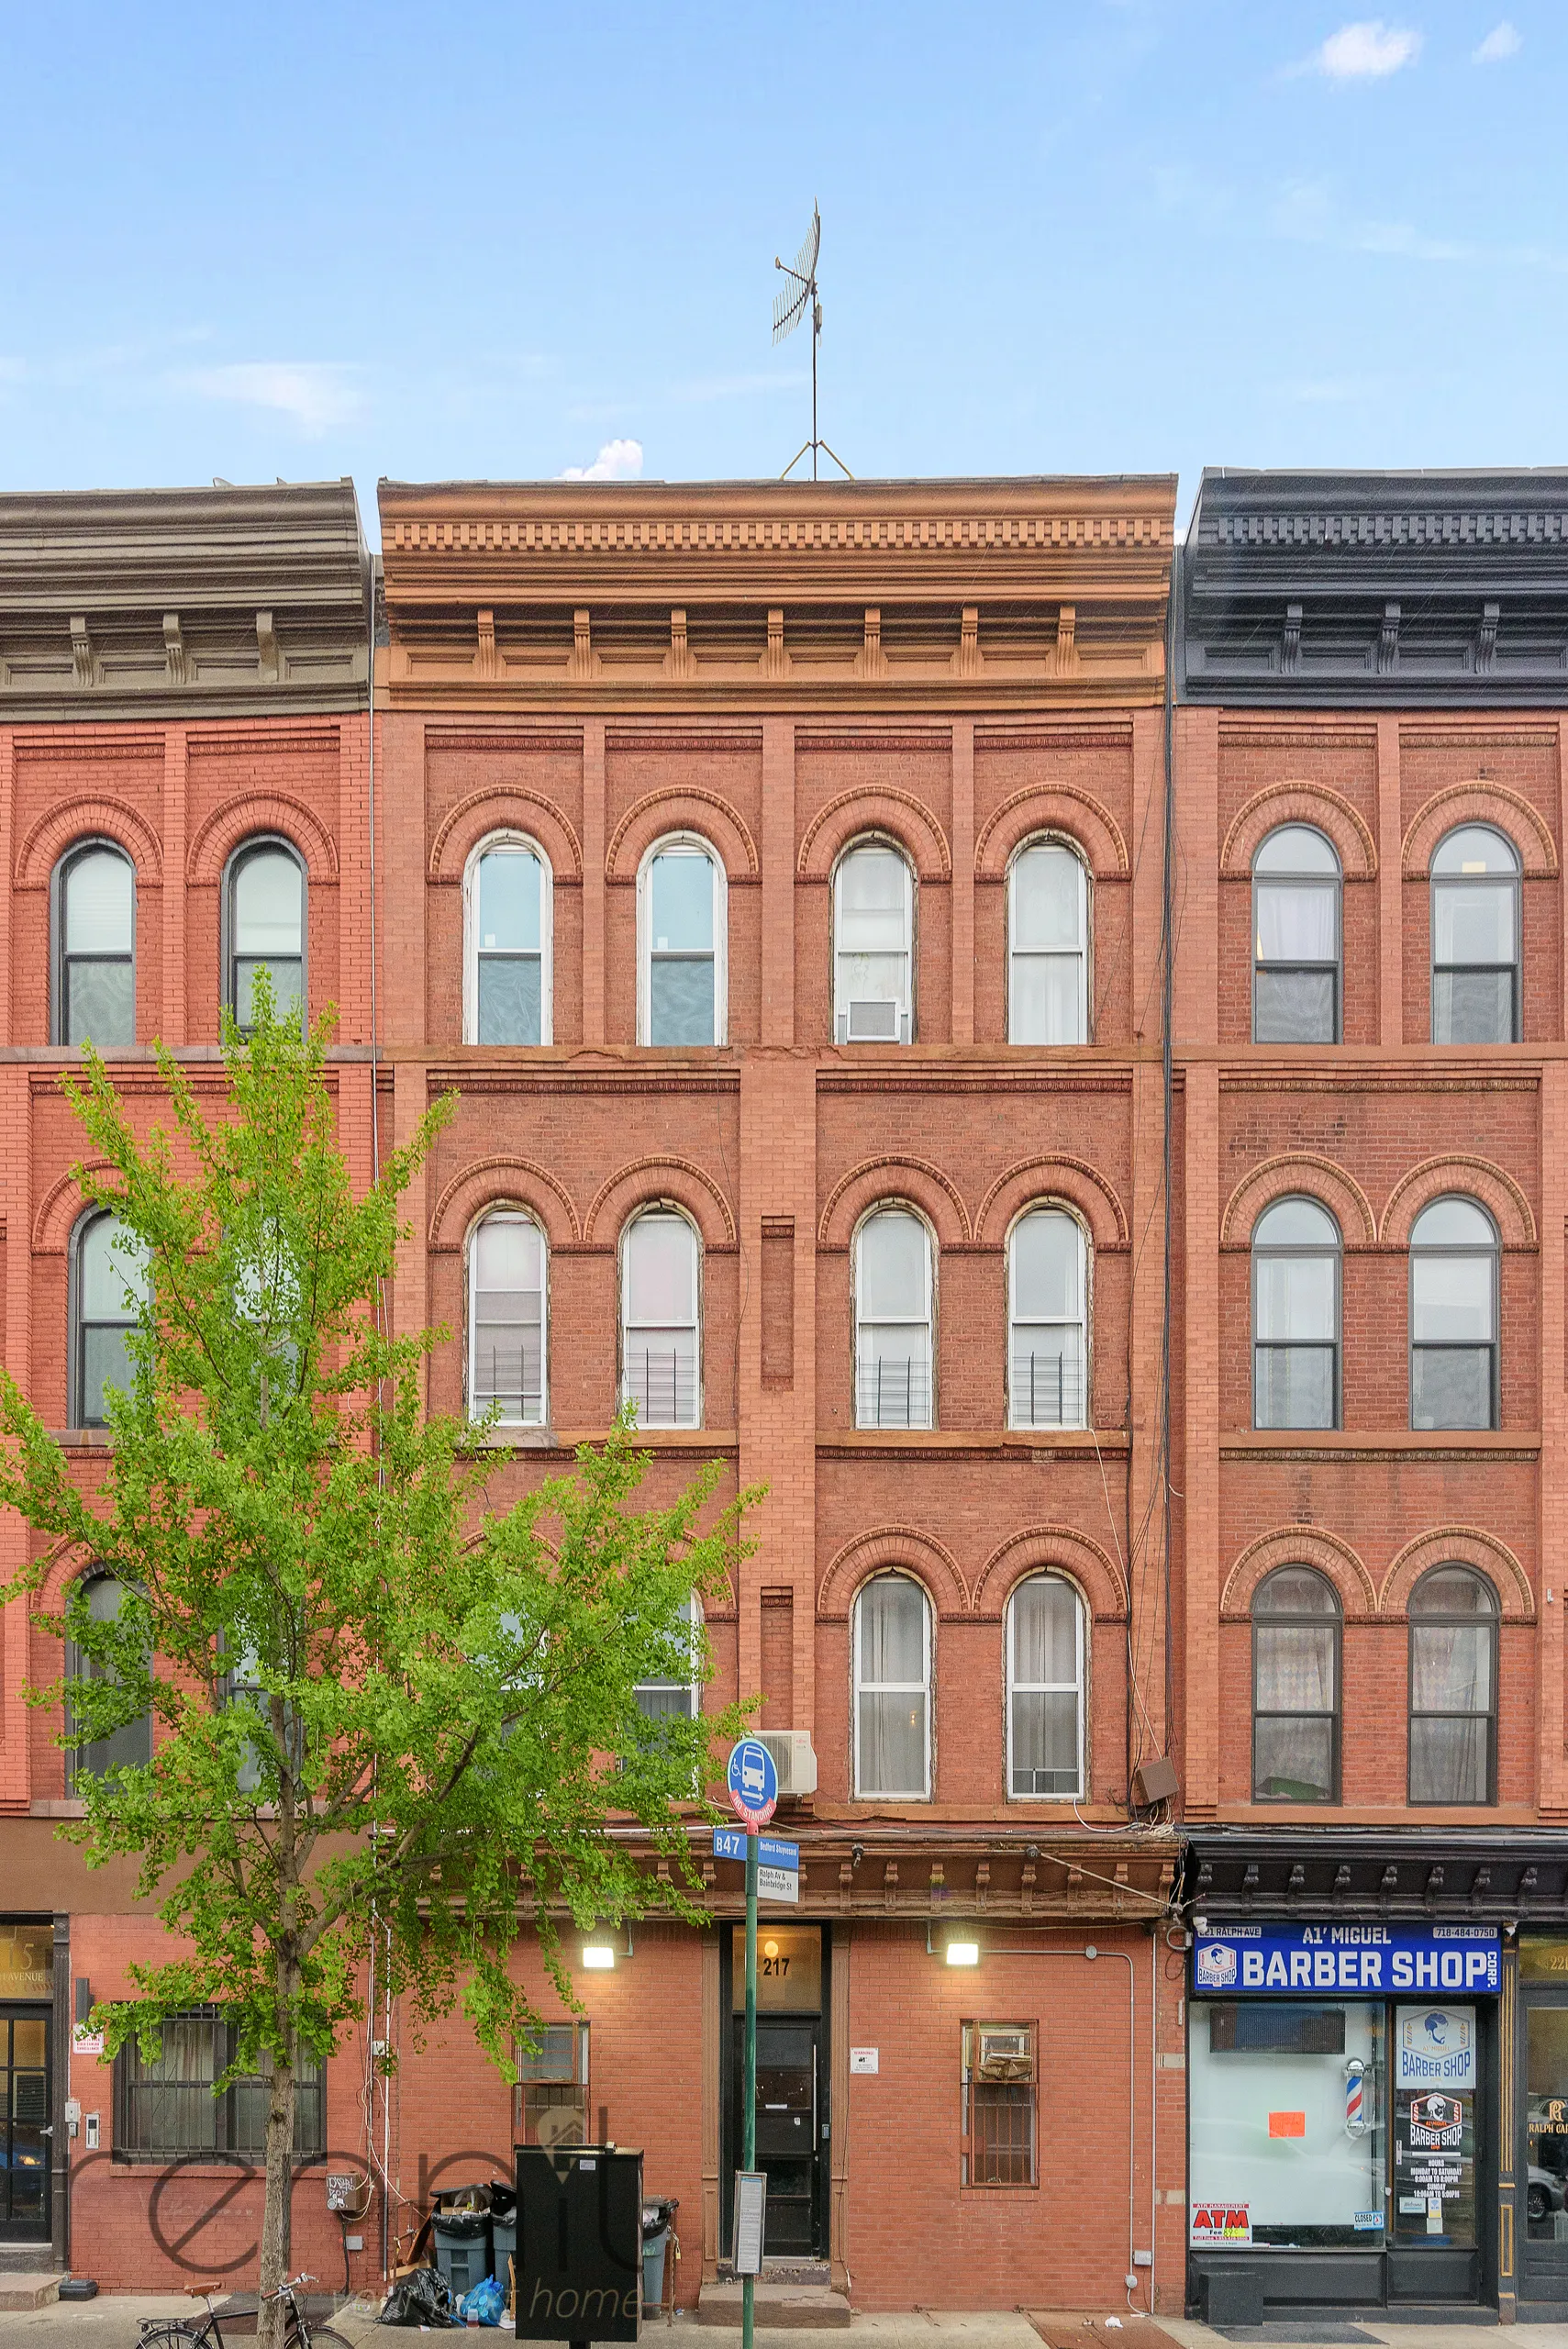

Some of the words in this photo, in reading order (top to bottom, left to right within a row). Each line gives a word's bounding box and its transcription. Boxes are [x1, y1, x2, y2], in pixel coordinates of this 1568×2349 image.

[734, 1795, 743, 1810] NO
[743, 1804, 773, 1821] STANDING
[716, 1835, 740, 1854] B47
[759, 1869, 774, 1879] Ralph
[774, 1871, 782, 1879] Av
[781, 1872, 786, 1881] &
[759, 1878, 786, 1891] Bainbridge
[786, 1882, 792, 1890] St
[1216, 1928, 1243, 1936] RALPH
[1243, 1928, 1261, 1936] AVE
[1331, 1927, 1392, 1944] MIGUEL
[1436, 1928, 1496, 1937] 718-484-0750
[762, 1958, 790, 1976] 217
[1242, 1951, 1382, 1987] BARBER
[1392, 1951, 1487, 1987] SHOP
[1487, 1951, 1497, 1987] CORP.
[8, 1973, 43, 1981] AVENUE
[1199, 1967, 1220, 1983] BARBER
[1220, 1967, 1236, 1983] SHOP
[1402, 2050, 1441, 2077] BARBER
[1443, 2050, 1471, 2077] SHOP
[1529, 2123, 1553, 2133] RALPH
[1410, 2124, 1440, 2146] BARBER
[1441, 2124, 1462, 2146] SHOP
[1428, 2159, 1445, 2167] HOURS
[1410, 2167, 1430, 2176] MONDAY
[1431, 2167, 1438, 2176] TO
[1438, 2167, 1462, 2176] SATURDAY
[1433, 2175, 1440, 2183] TO
[1435, 2190, 1440, 2199] TO
[1193, 2210, 1249, 2229] ATM
[1354, 2214, 1373, 2223] CLOSED
